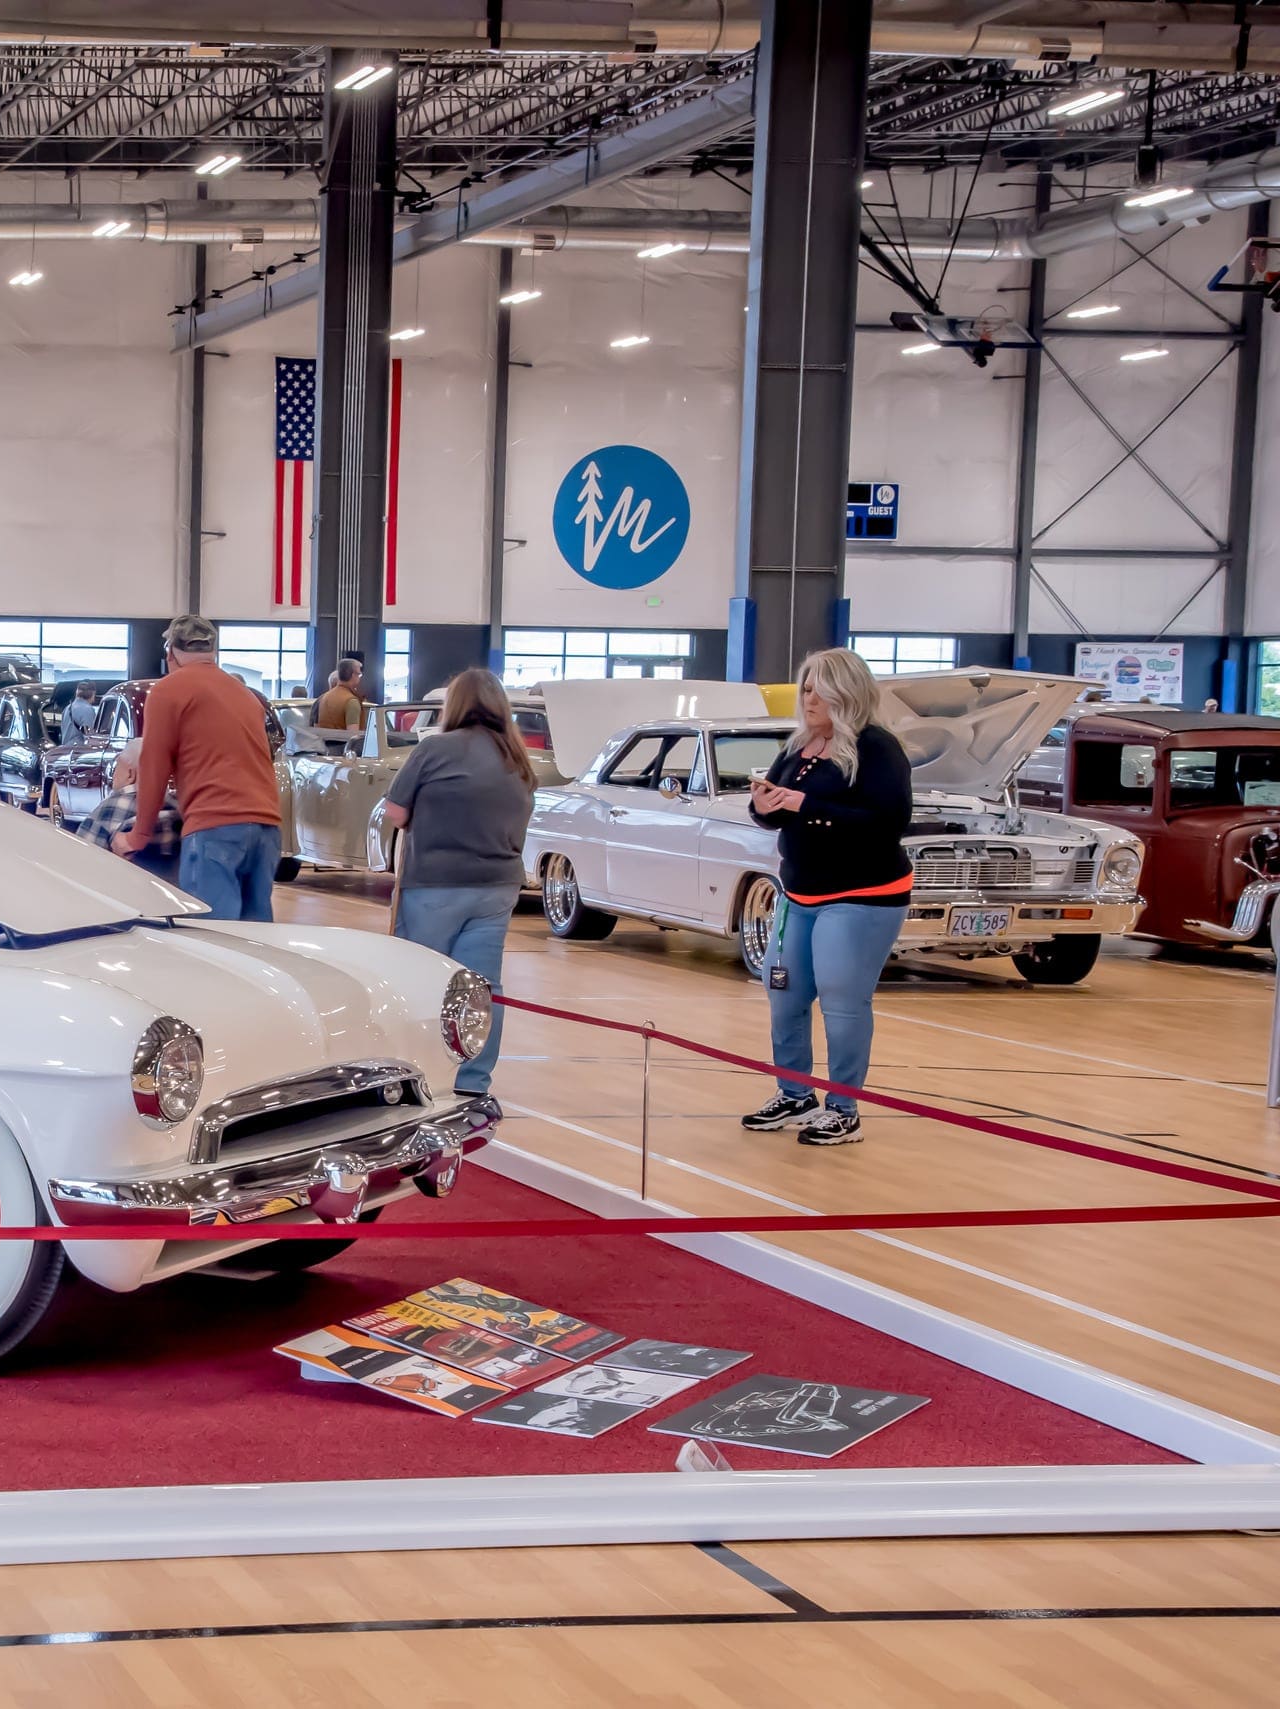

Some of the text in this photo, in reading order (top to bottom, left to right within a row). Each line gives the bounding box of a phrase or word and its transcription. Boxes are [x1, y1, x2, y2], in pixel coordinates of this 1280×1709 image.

[868, 507, 893, 515] GUEST
[953, 914, 1008, 930] ZCY 585
